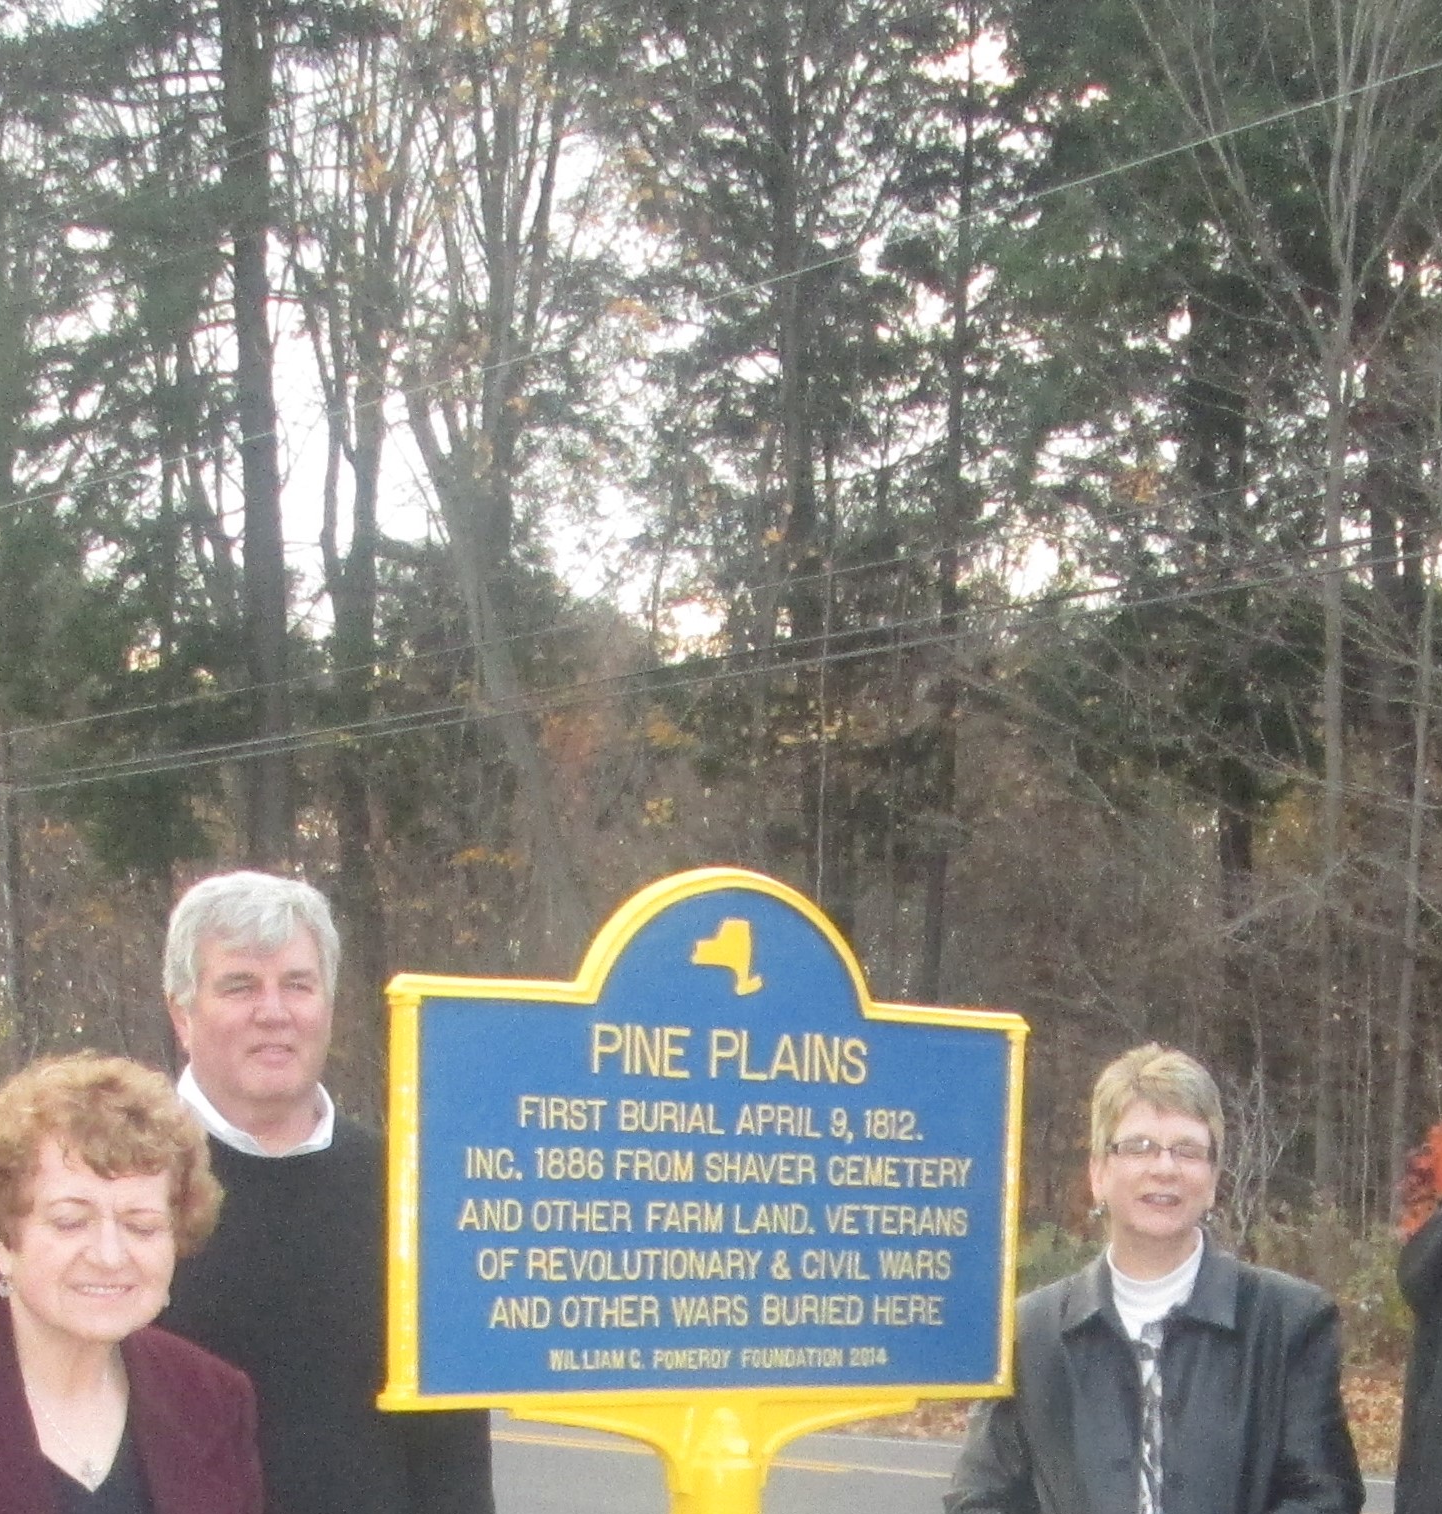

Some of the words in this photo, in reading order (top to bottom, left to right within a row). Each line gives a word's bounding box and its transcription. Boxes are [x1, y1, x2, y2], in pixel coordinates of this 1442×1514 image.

[590, 1022, 692, 1079] PINE
[709, 1028, 868, 1085] PLAINS
[519, 1095, 608, 1131] FIRST
[619, 1099, 725, 1135] BURIAL
[736, 1103, 822, 1138] APRIL
[831, 1108, 854, 1142] 9,
[865, 1108, 924, 1141] 1812.
[466, 1147, 523, 1180] INC.
[536, 1147, 605, 1180] 1886
[614, 1148, 696, 1183] FROM
[704, 1151, 816, 1185] SHAVER
[828, 1155, 971, 1188] CEMETERY
[457, 1199, 524, 1233] AND
[531, 1199, 632, 1233] OTHER
[645, 1201, 725, 1233] FARM
[734, 1203, 815, 1235] LAND.
[827, 1204, 968, 1237] VETERANS
[478, 1248, 520, 1281] OF
[526, 1247, 761, 1282] REVOLUTIONARY
[770, 1250, 792, 1281] &
[802, 1250, 870, 1281] CIVIL
[880, 1249, 951, 1280] WARS
[490, 1296, 553, 1329] AND
[560, 1294, 660, 1329] OTHER
[671, 1294, 749, 1327] WARS
[761, 1294, 864, 1327] BURIED
[872, 1294, 941, 1326] HERE
[549, 1349, 625, 1371] WILLIAM
[629, 1349, 645, 1371] C.
[652, 1348, 732, 1371] POMEROY
[741, 1347, 845, 1369] FOUNDATION
[849, 1347, 887, 1367] 2014
